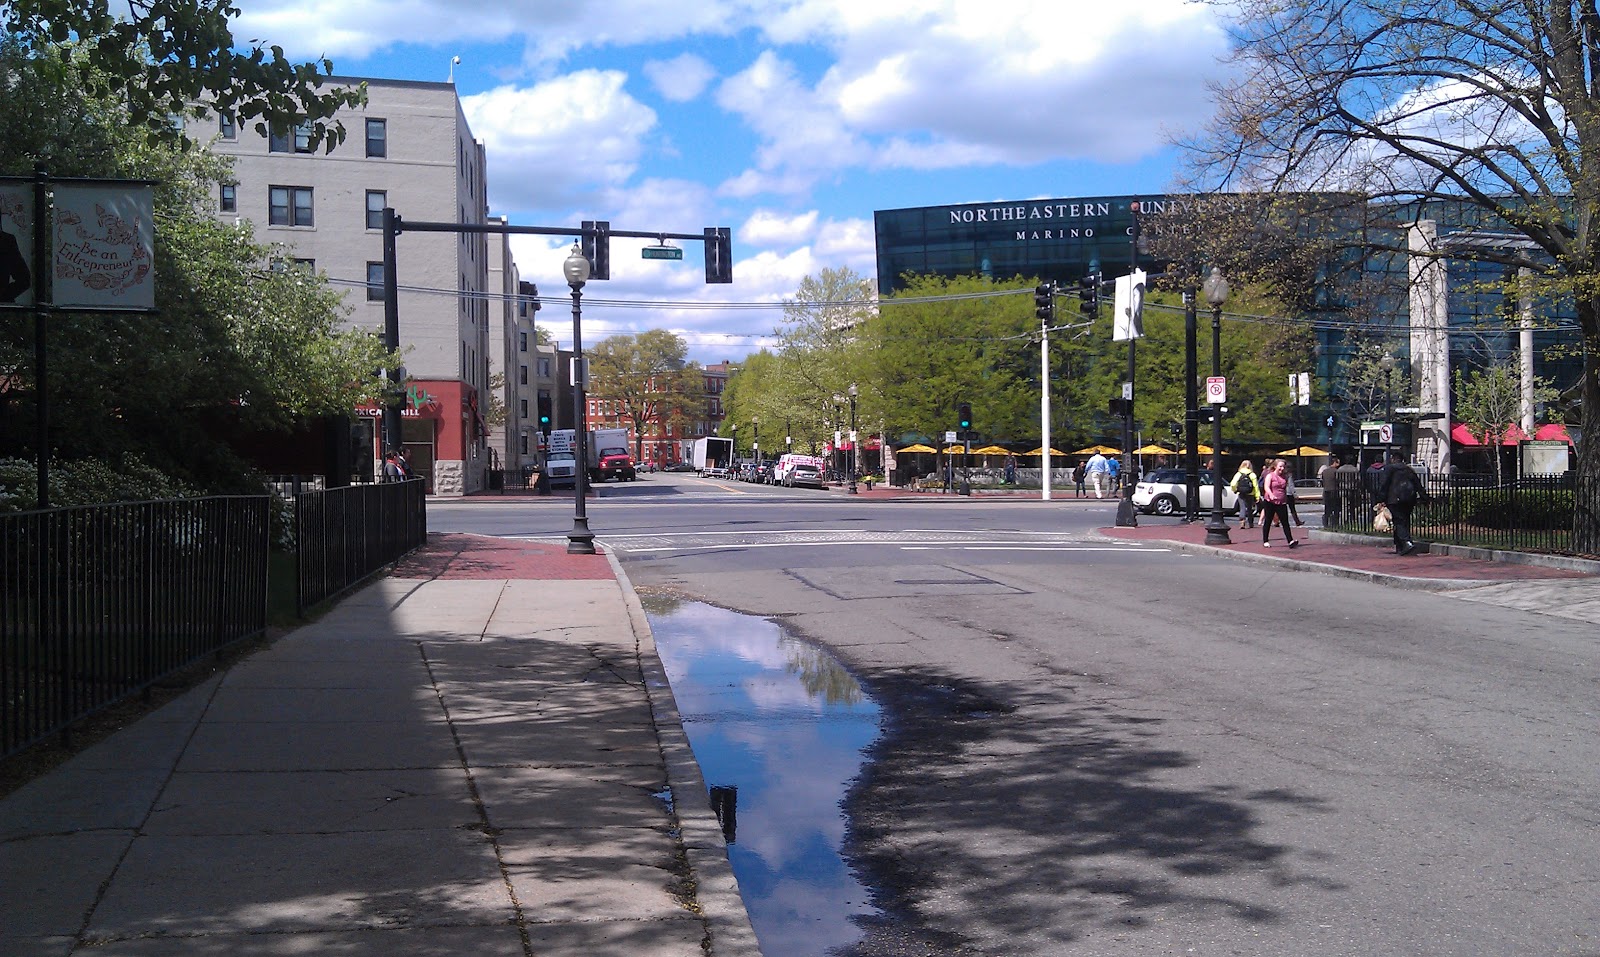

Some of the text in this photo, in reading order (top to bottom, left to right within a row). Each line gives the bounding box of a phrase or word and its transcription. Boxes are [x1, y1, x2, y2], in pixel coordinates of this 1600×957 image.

[950, 203, 1110, 224] NORTHEASTERN
[1016, 228, 1094, 240] MARINO
[59, 242, 133, 272] Entrepreneur
[101, 251, 118, 260] an
